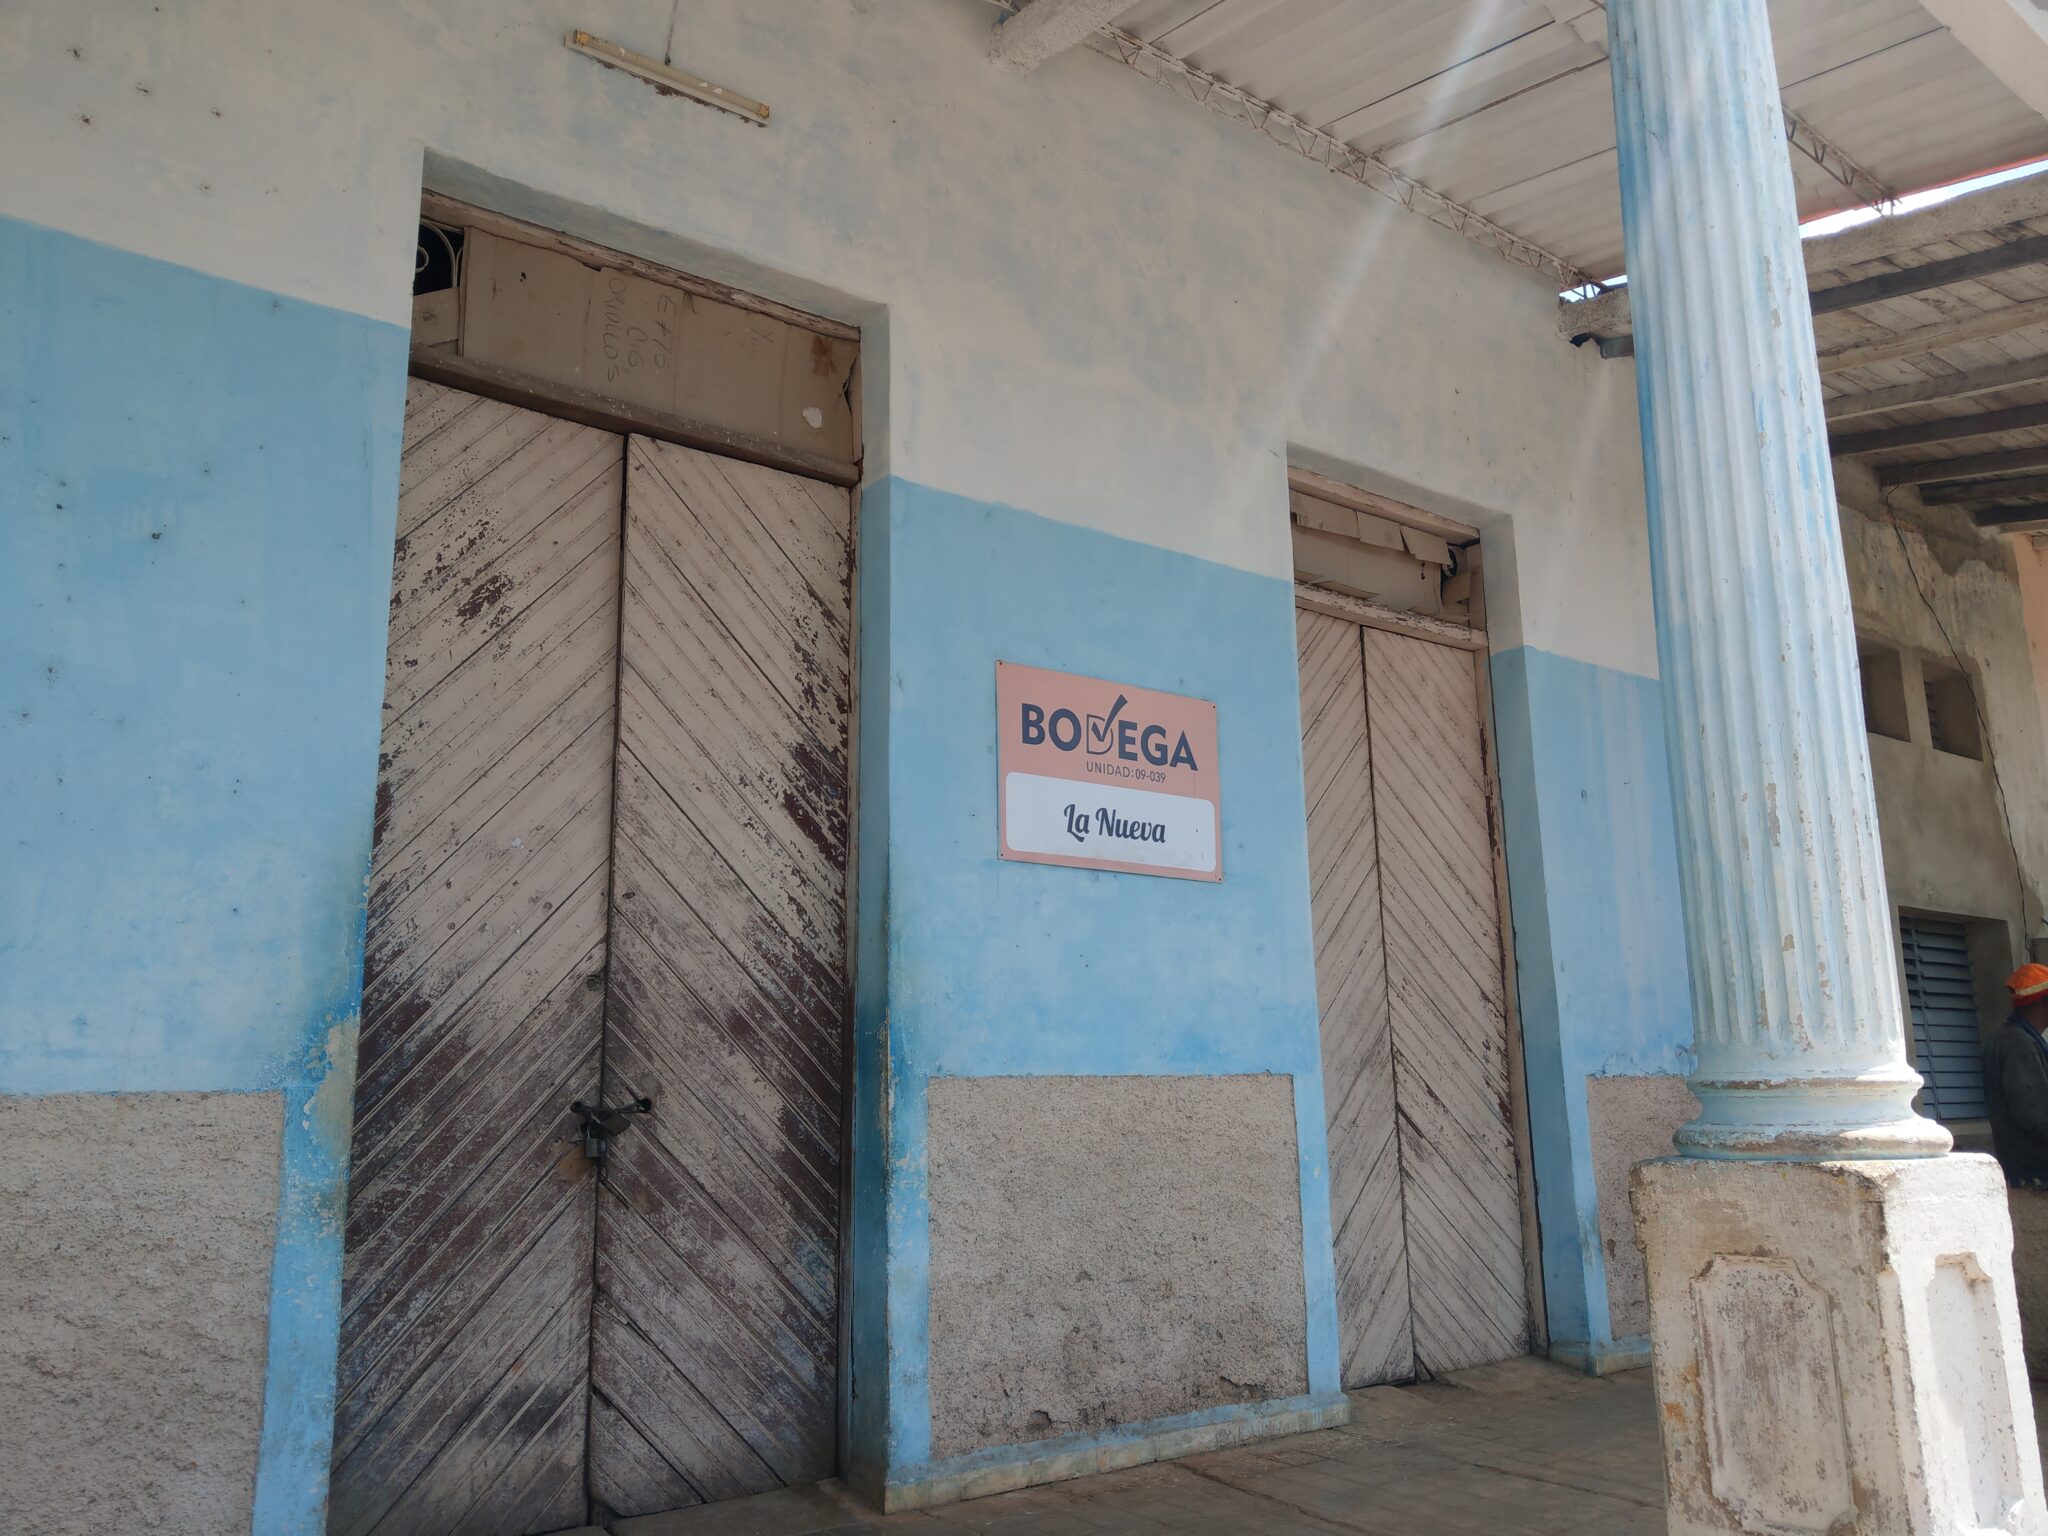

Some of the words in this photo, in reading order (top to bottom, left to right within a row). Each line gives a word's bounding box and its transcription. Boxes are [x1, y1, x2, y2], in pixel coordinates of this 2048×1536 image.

[1021, 694, 1198, 771] BODEGA
[1063, 803, 1091, 843] La
[1095, 807, 1167, 844] Nueva
